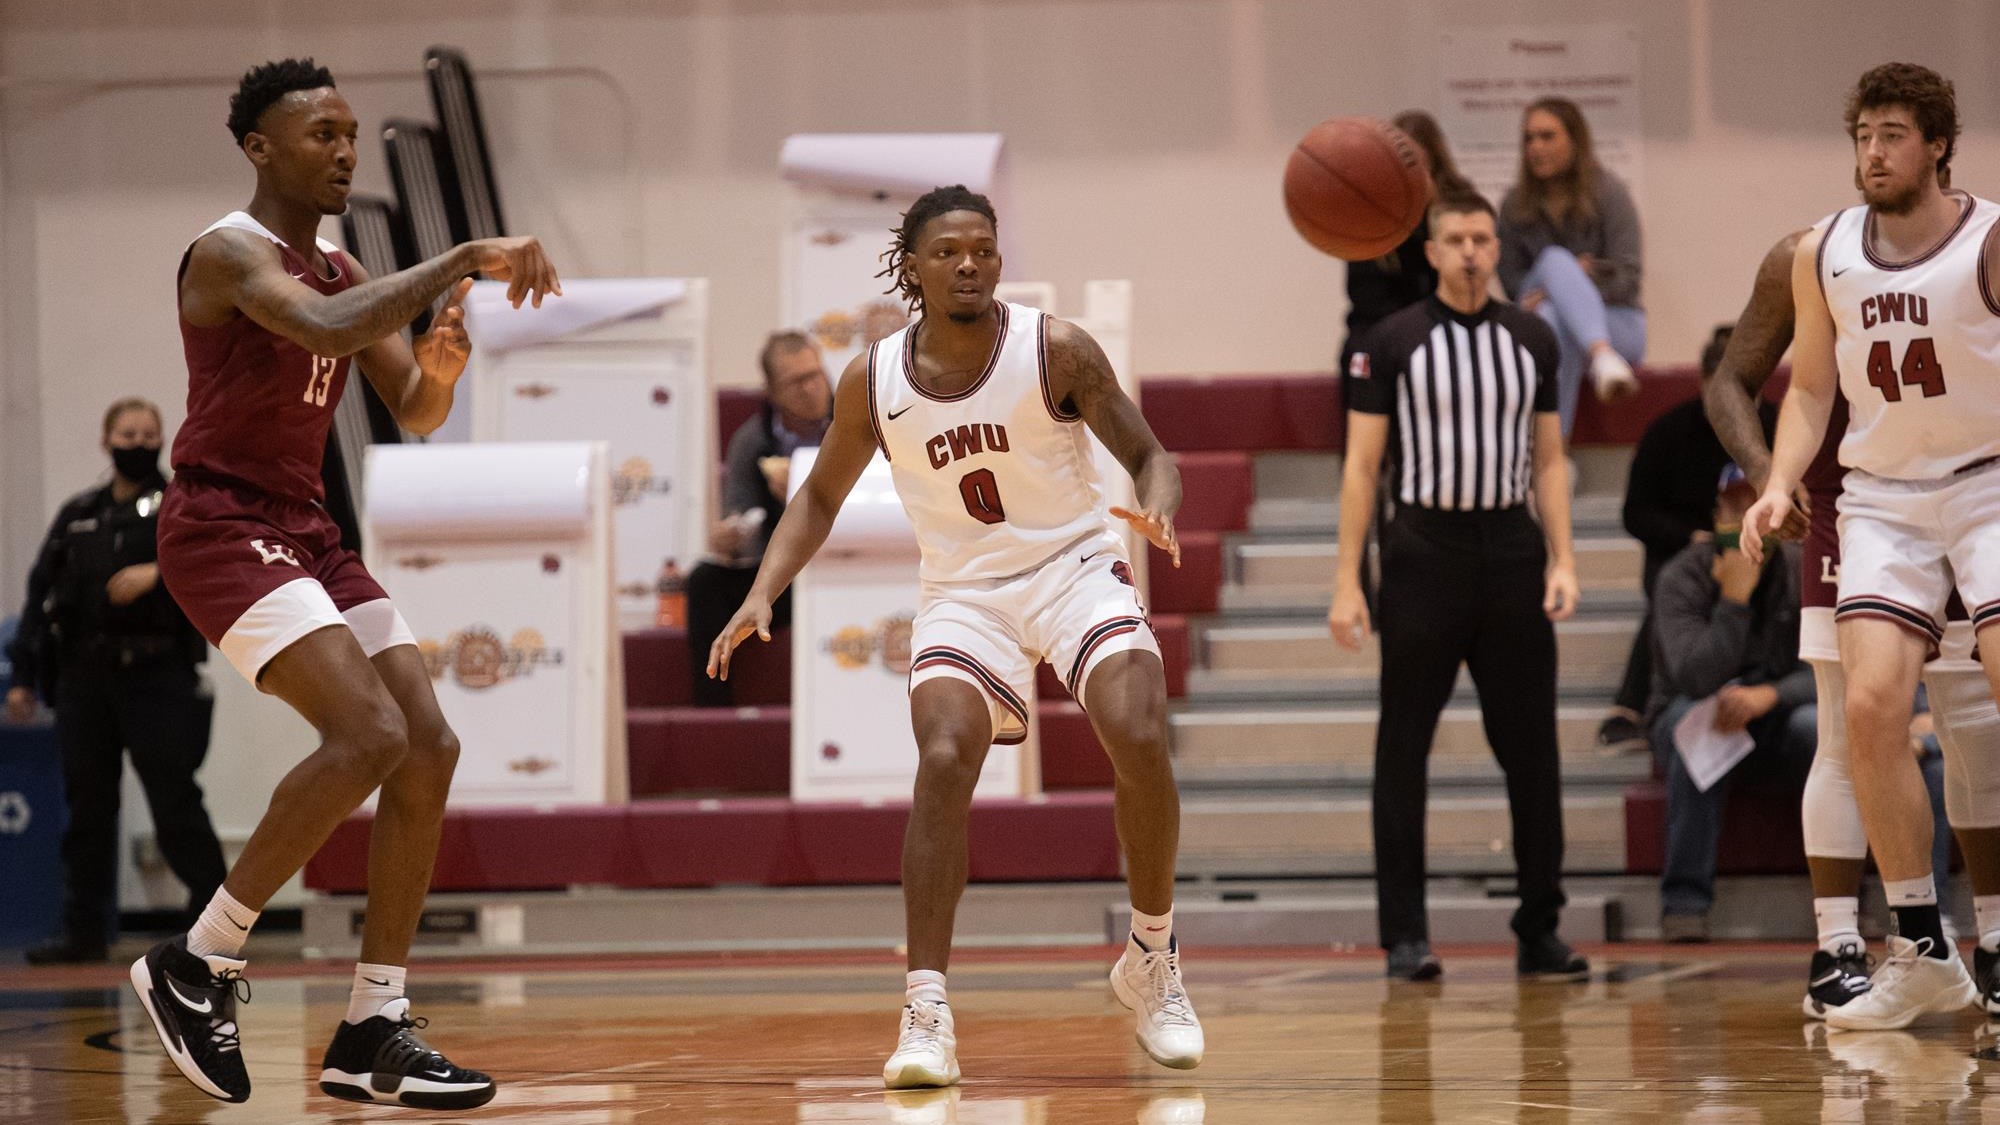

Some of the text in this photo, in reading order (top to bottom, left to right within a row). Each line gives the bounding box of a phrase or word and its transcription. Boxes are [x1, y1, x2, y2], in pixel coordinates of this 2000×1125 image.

[1861, 292, 1929, 330] CWU
[303, 353, 337, 407] 13
[1866, 337, 1947, 402] 44
[925, 423, 1010, 470] CWU
[958, 467, 1006, 525] 0
[1821, 555, 1841, 583] L
